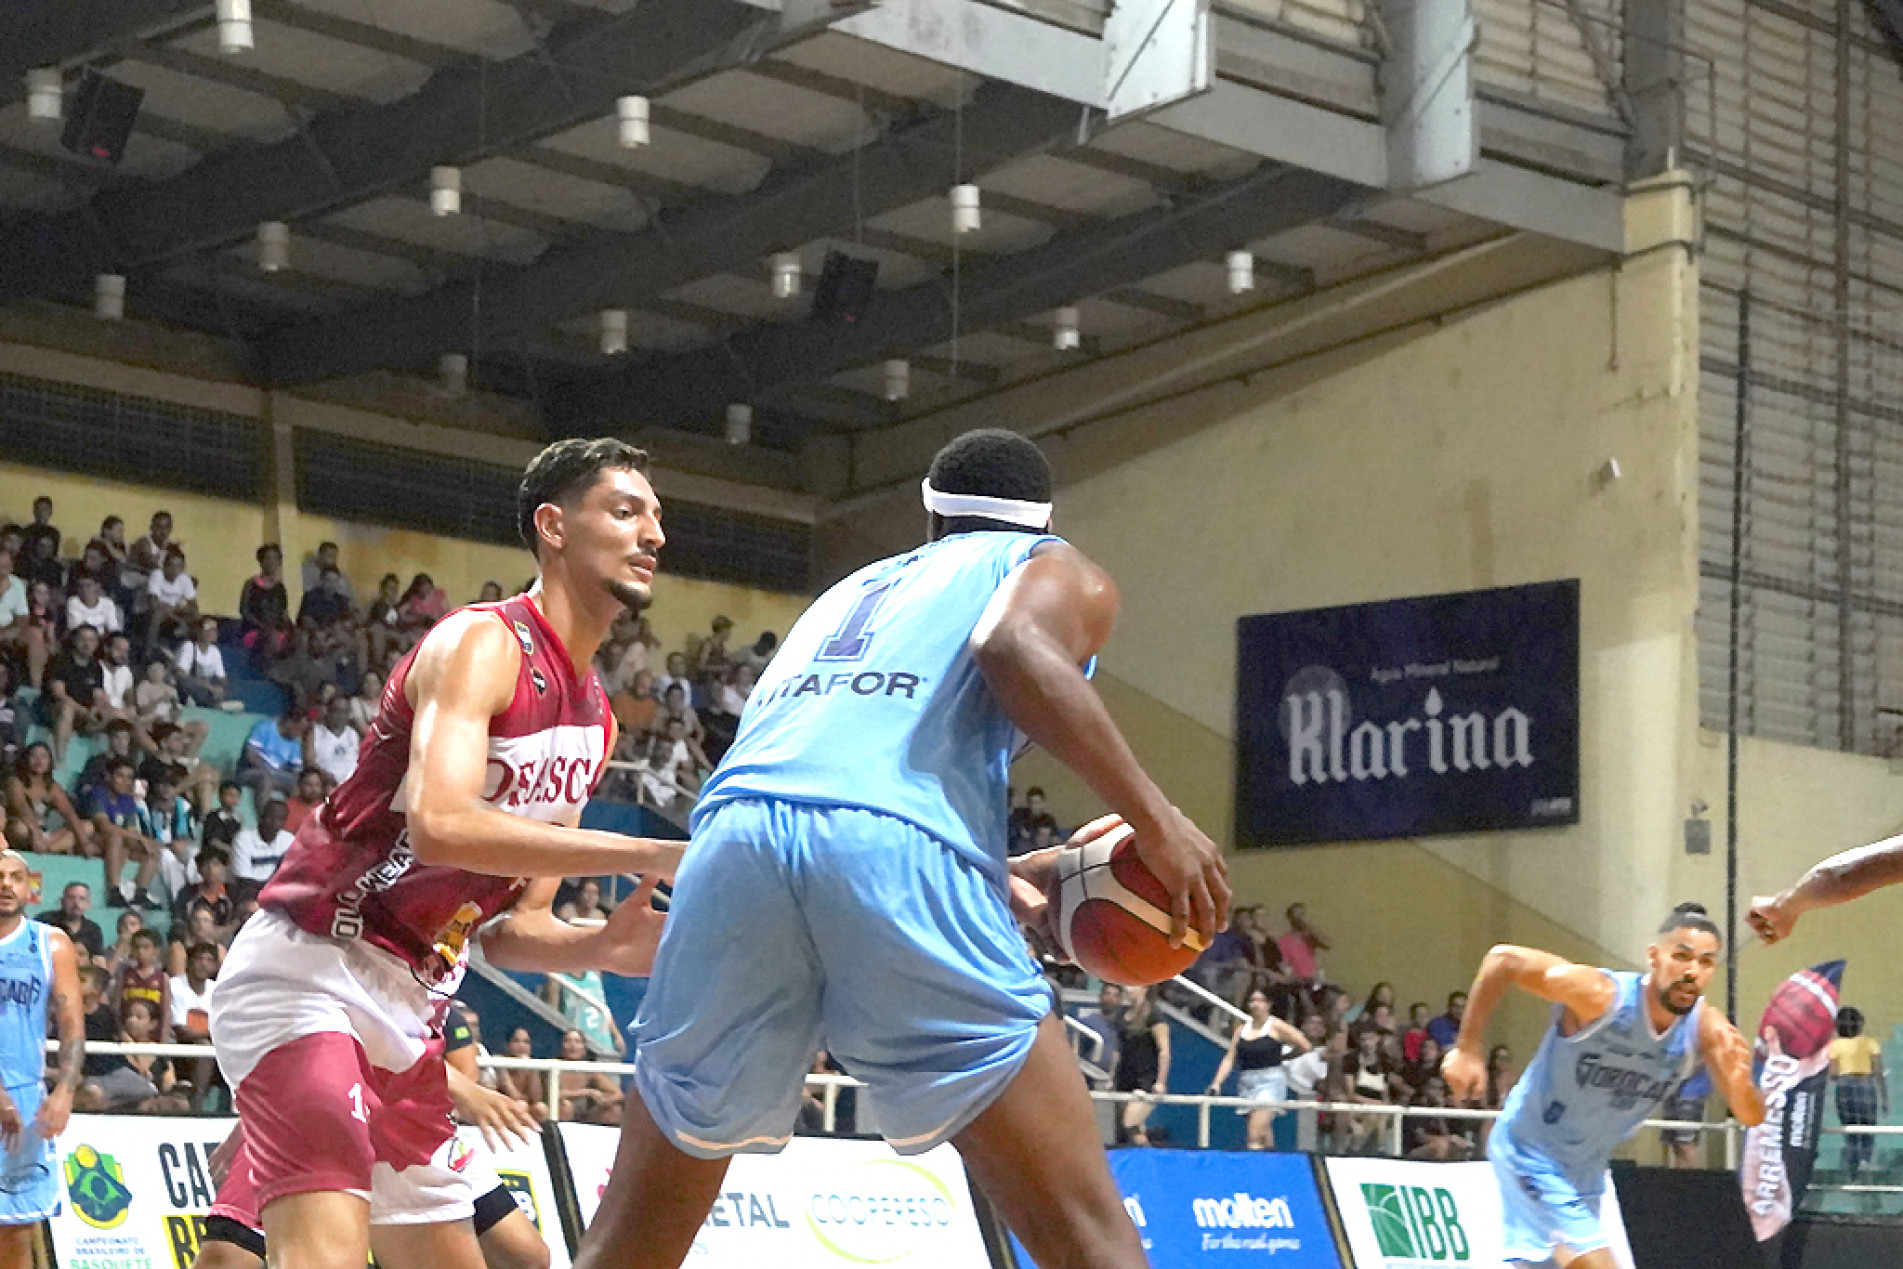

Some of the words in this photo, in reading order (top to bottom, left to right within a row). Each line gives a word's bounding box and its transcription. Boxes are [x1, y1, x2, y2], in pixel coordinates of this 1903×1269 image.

[813, 577, 902, 662] 1
[705, 1192, 790, 1229] ETAL
[1193, 1192, 1295, 1229] molten
